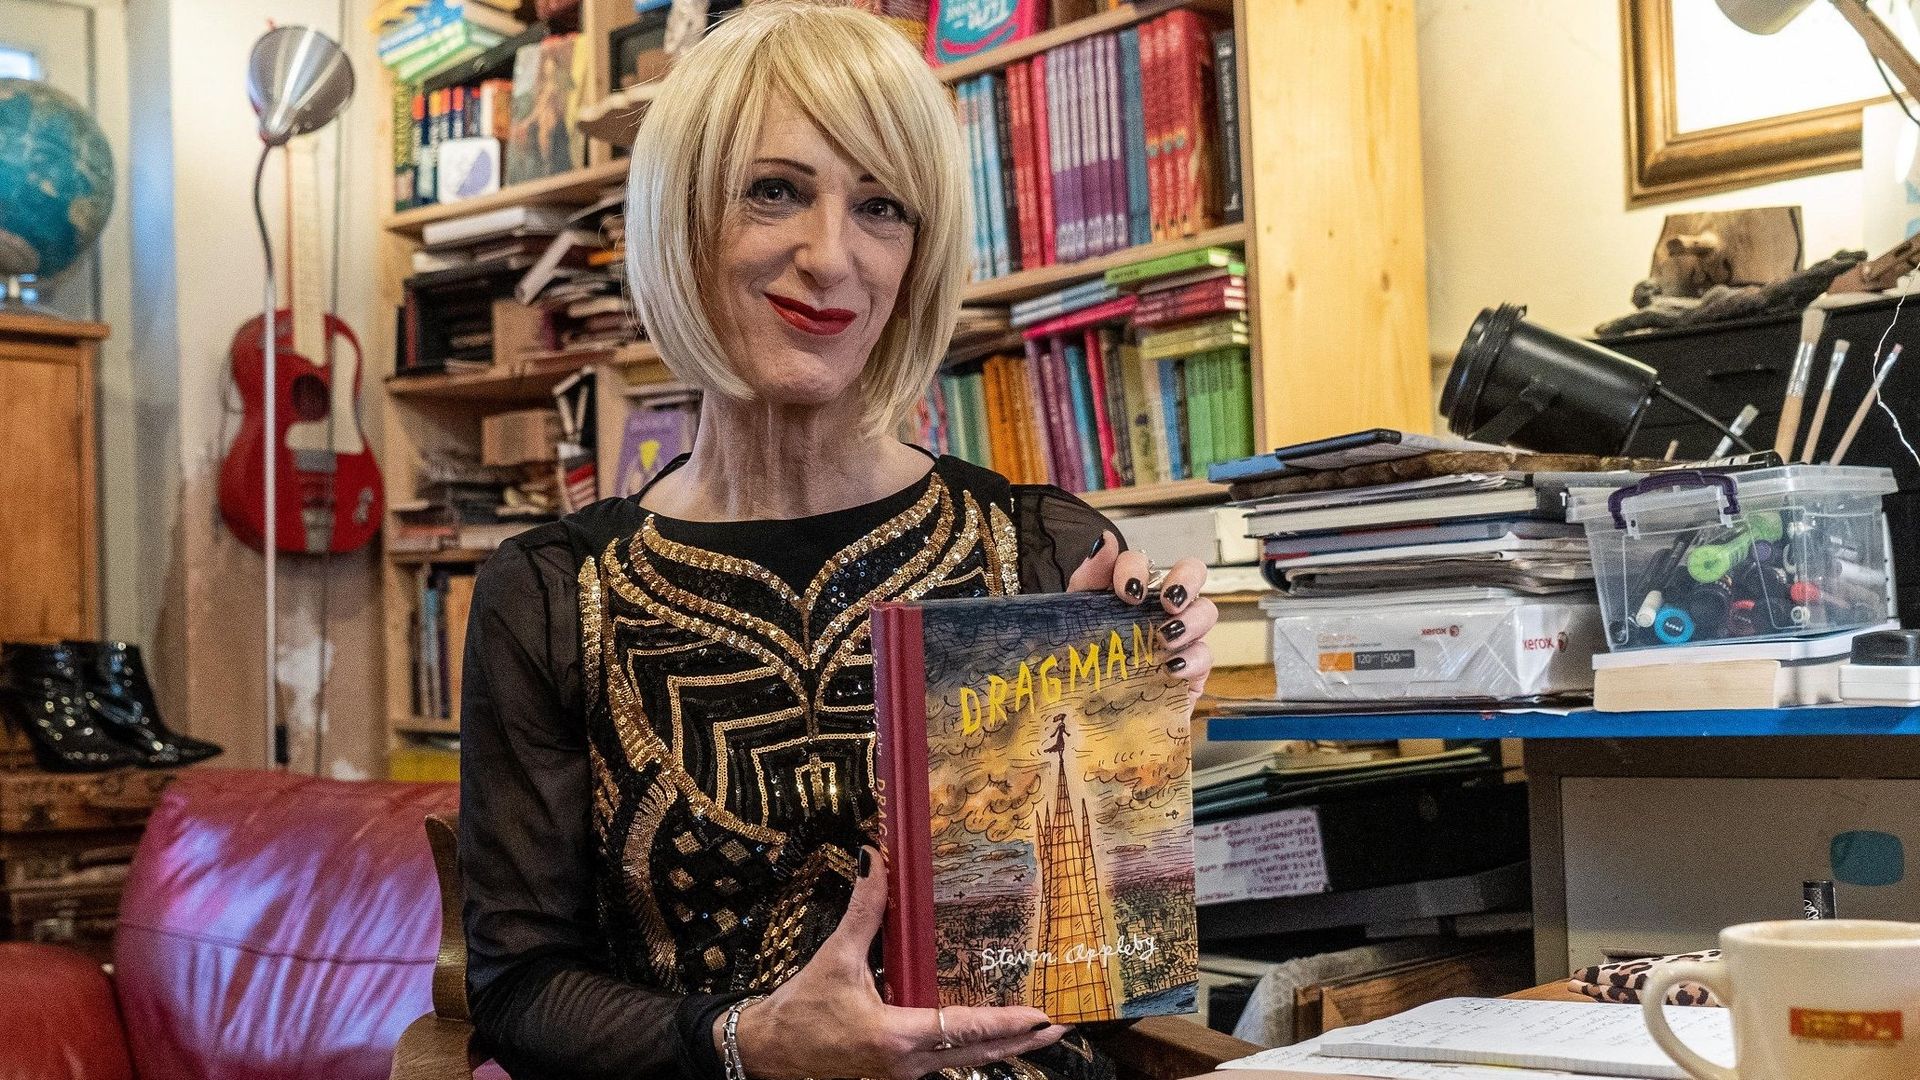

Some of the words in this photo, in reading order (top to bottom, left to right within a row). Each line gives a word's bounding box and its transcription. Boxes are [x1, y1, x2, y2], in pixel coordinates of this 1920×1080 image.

[1420, 627, 1447, 636] xerox
[1522, 637, 1554, 651] xerox
[1384, 653, 1401, 663] 500
[960, 619, 1155, 736] DRAGMAN
[980, 946, 1058, 971] Steven
